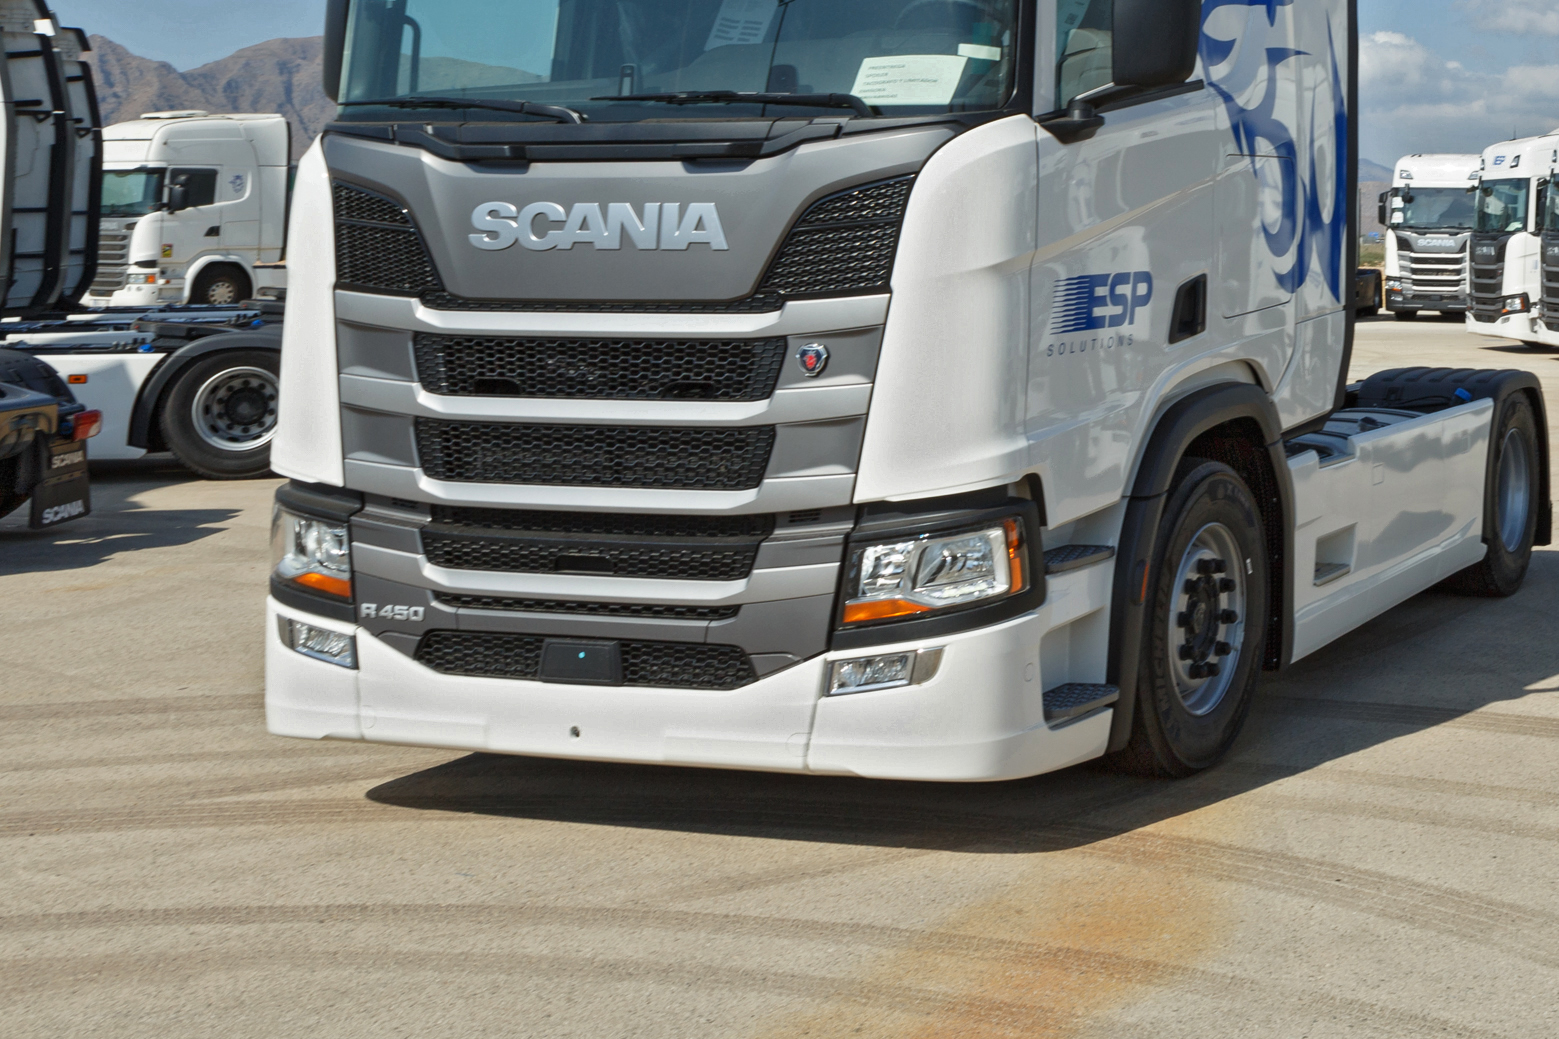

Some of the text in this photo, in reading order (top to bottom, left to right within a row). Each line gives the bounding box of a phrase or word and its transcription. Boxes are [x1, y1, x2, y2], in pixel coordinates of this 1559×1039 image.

[468, 201, 730, 251] SCANIA
[1416, 238, 1456, 247] SCANIA
[1072, 271, 1153, 331] ESP
[1046, 333, 1134, 358] SOLUTIONS
